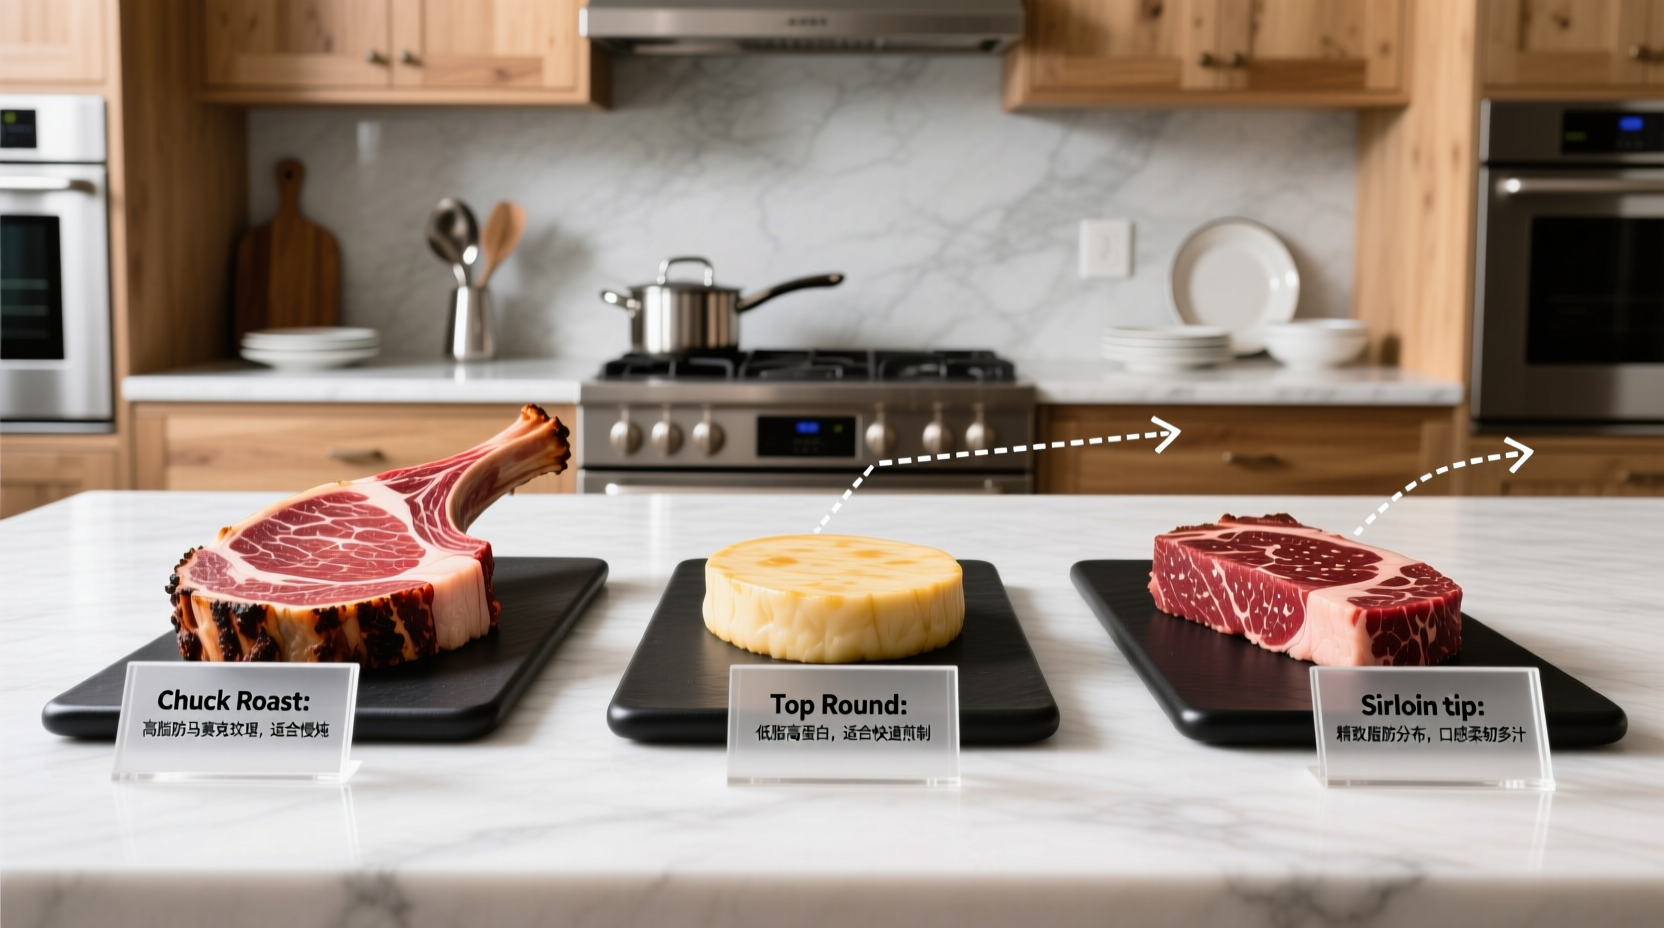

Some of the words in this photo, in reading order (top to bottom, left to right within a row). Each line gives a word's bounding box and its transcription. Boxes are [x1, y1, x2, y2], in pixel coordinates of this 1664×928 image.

[157, 689, 231, 711] Chuck
[236, 690, 310, 712] Roast:
[770, 693, 814, 721] Top
[821, 693, 908, 715] Round:
[1361, 693, 1438, 716] Sirloin
[1442, 693, 1485, 721] tip:
